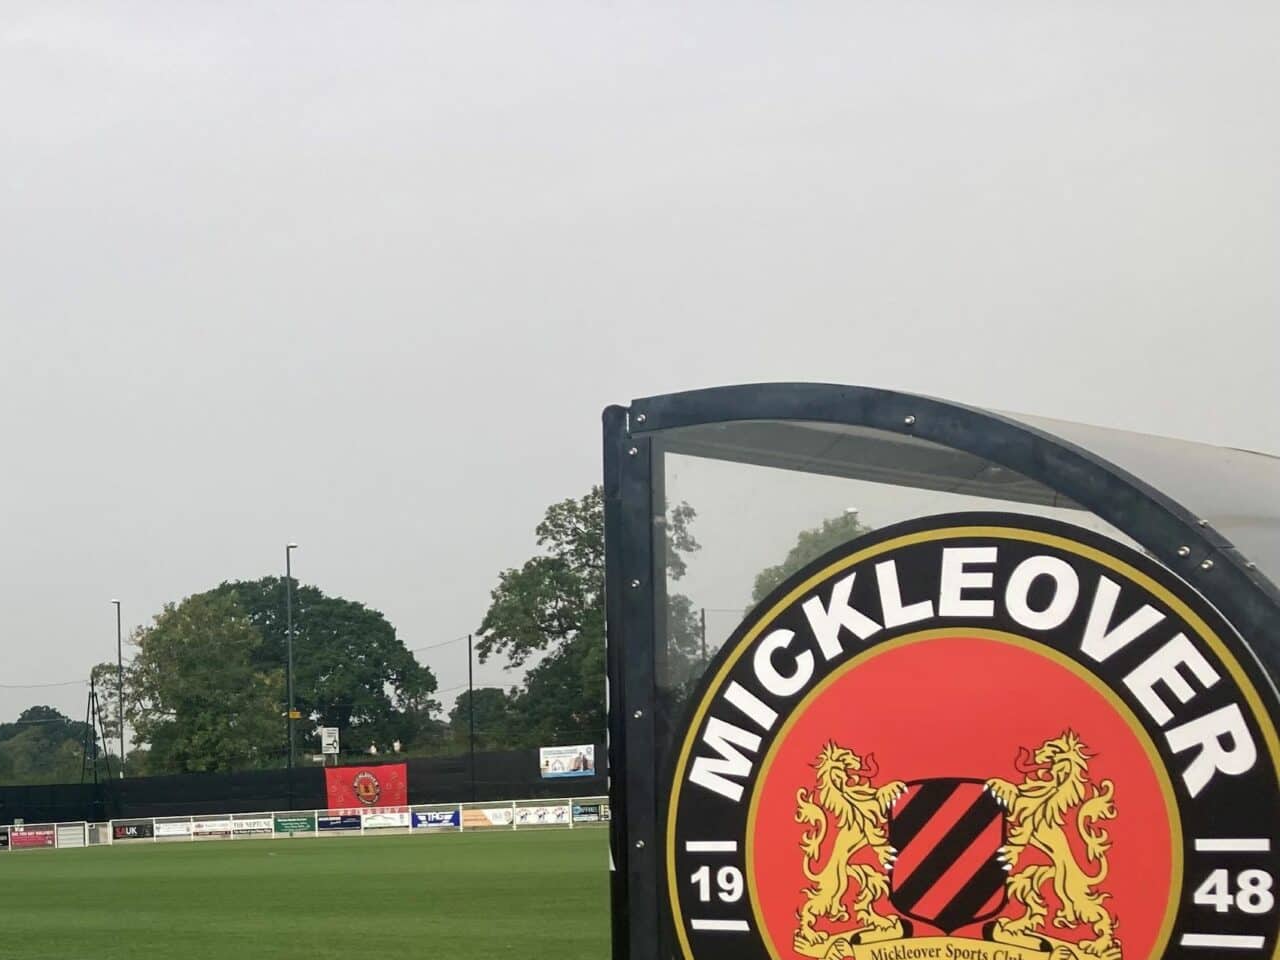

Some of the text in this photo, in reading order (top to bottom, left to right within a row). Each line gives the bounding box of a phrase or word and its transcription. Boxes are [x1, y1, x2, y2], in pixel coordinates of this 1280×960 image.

[688, 546, 1258, 802] MICKLEOVER
[690, 865, 745, 903] 19
[1193, 868, 1275, 915] 48
